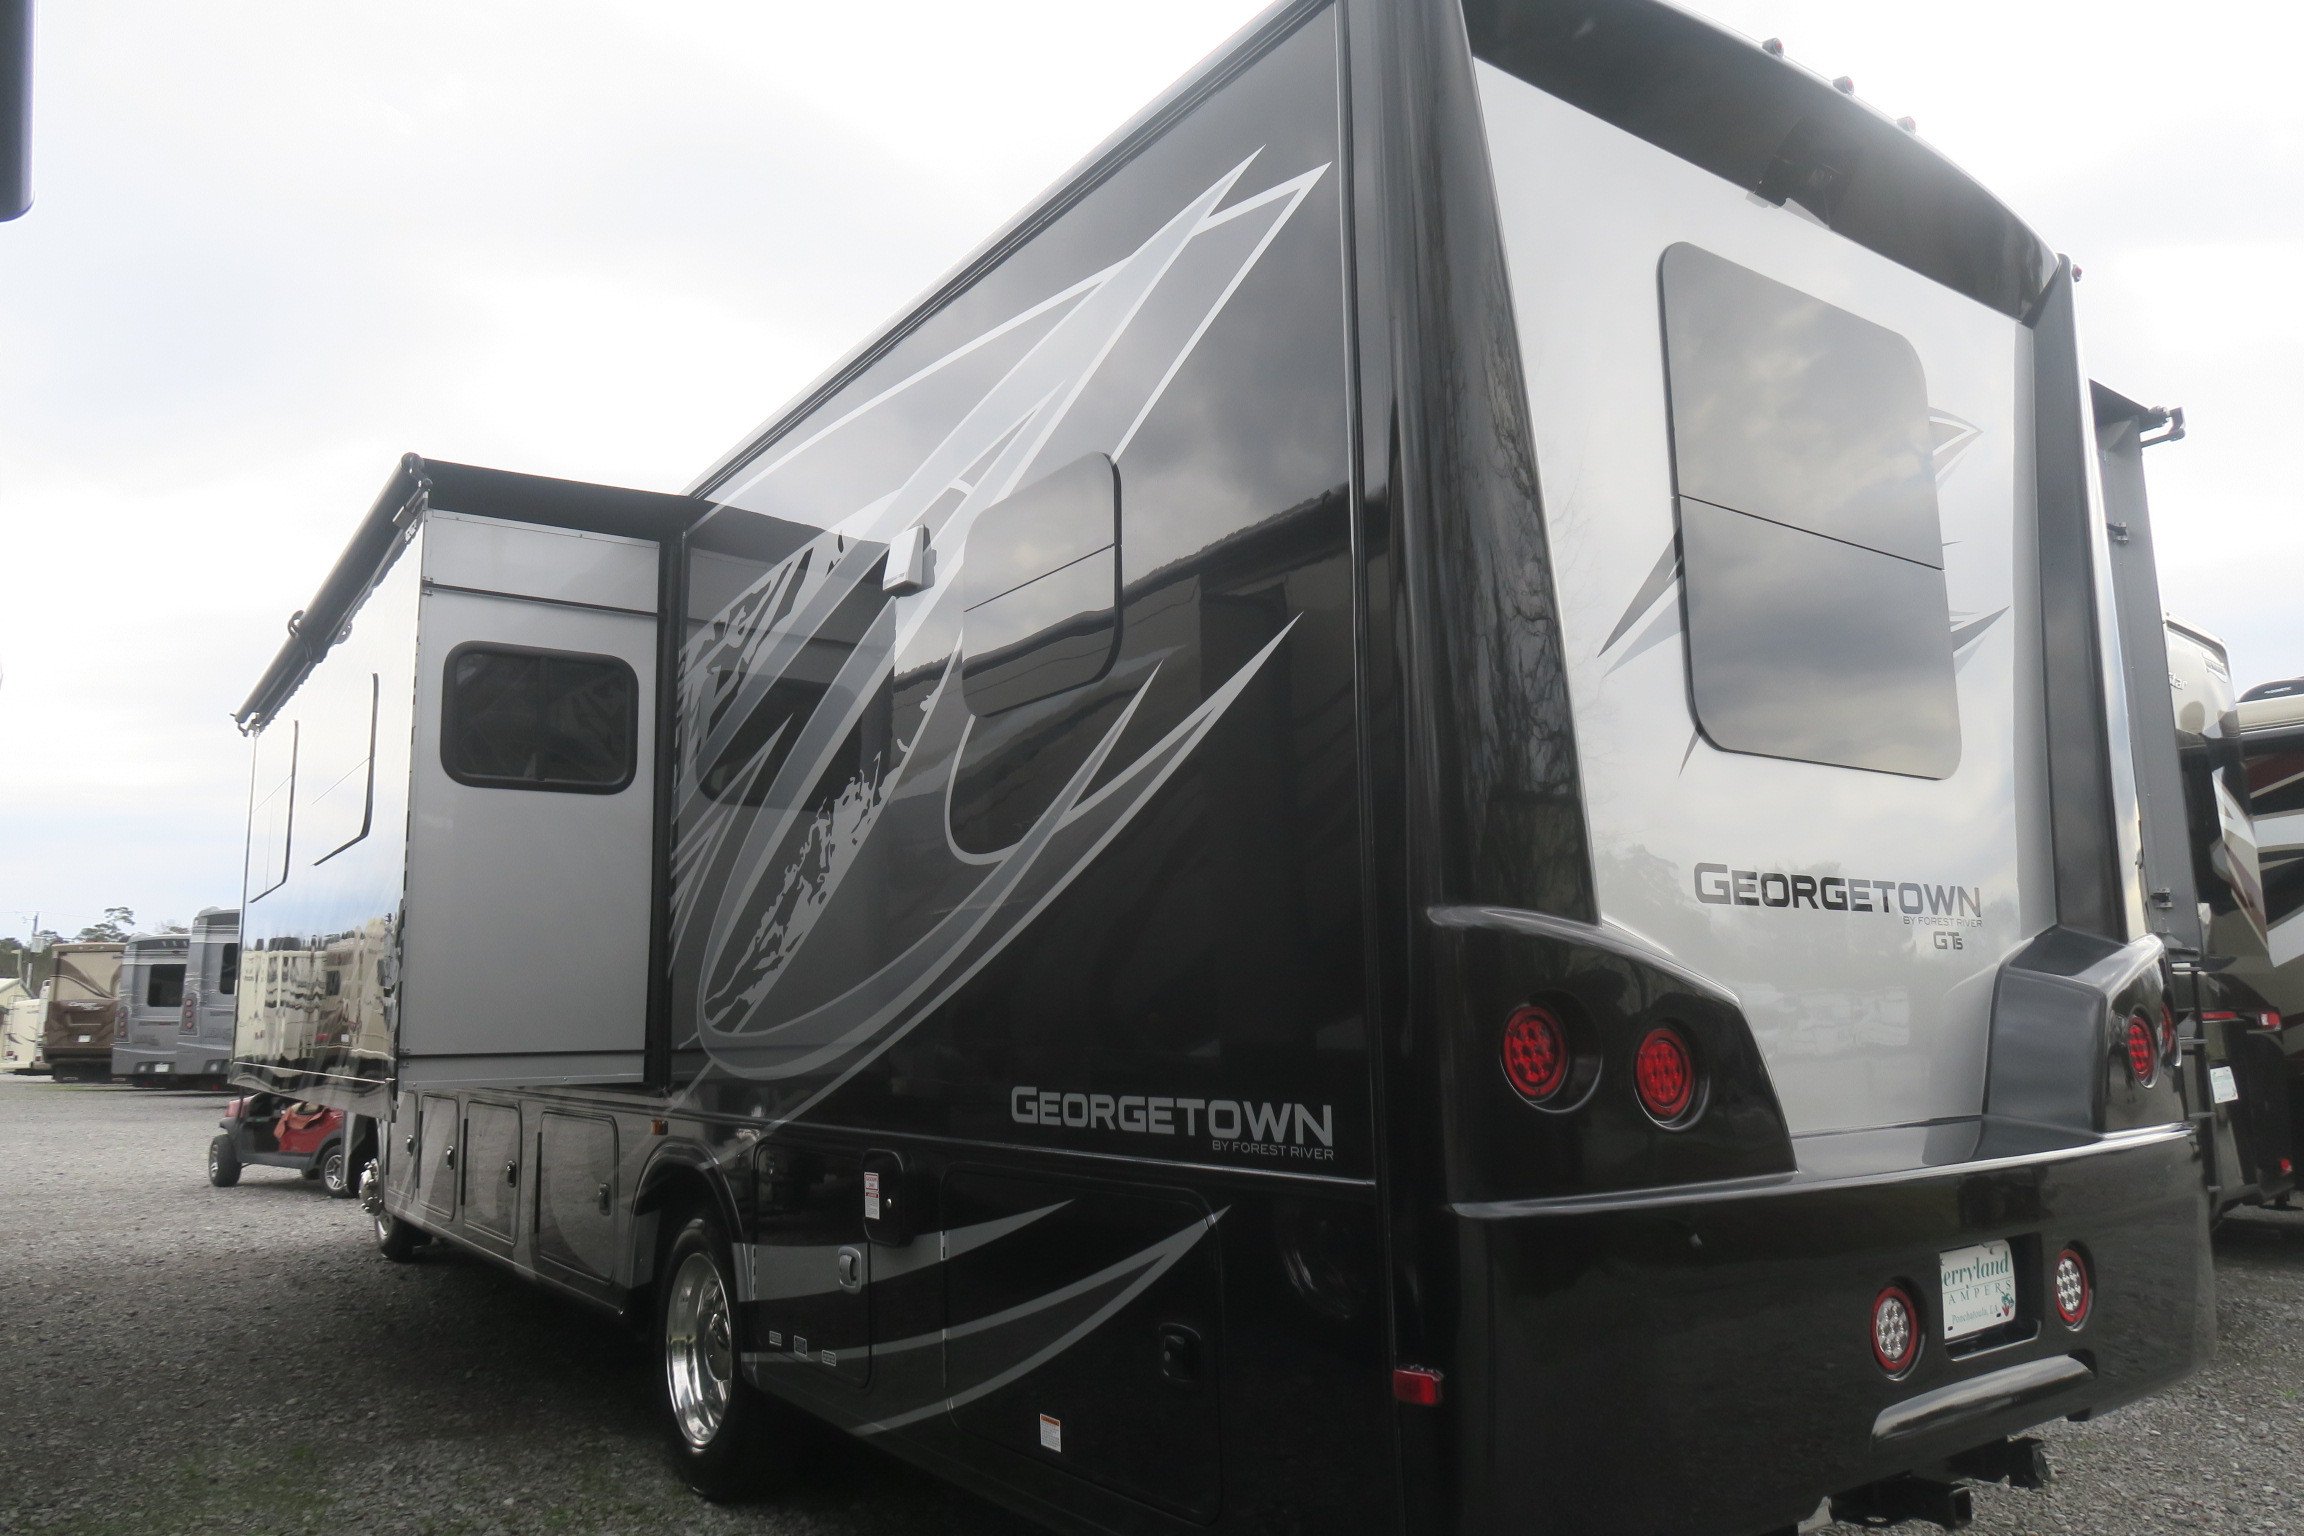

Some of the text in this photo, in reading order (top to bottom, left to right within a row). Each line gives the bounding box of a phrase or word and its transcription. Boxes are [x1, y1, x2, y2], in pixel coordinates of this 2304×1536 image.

[1694, 862, 1982, 918] GEORGETOWN
[1903, 915, 1983, 928] BY FOREST RIVER
[1011, 1086, 1333, 1147] GEORGETOWN
[1212, 1140, 1334, 1161] BY FOREST RIVER
[1942, 1250, 2009, 1287] erryland
[1948, 1280, 2012, 1306] AMPERS
